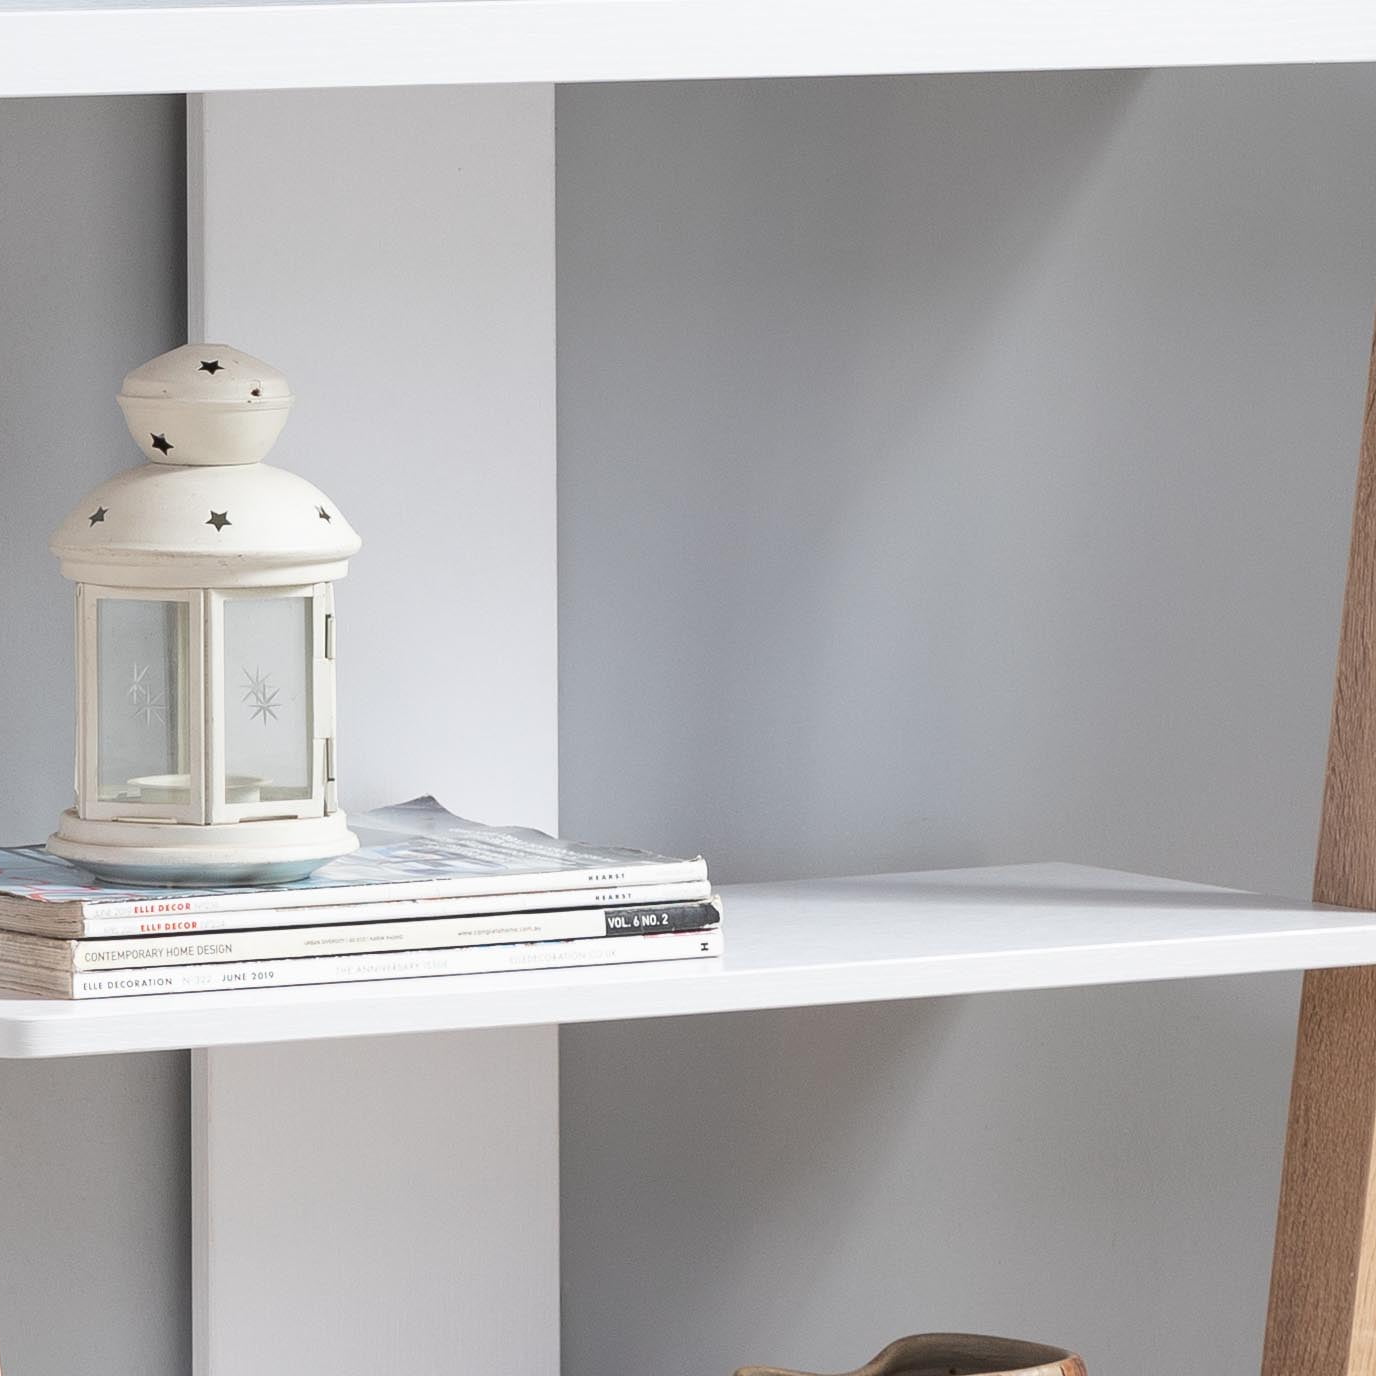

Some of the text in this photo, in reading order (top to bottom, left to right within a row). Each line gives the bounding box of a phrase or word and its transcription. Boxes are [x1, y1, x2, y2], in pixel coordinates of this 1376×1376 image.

[588, 873, 625, 881] HEARST
[595, 892, 632, 901] HEARST
[134, 906, 155, 914] ELLE
[158, 903, 191, 912] DECOR
[140, 924, 162, 932] ELLE
[165, 921, 198, 931] DECOR
[608, 913, 669, 929] VOL. 6 NO. 2
[85, 943, 232, 962] CONTEMPORARY HOME DESIGN
[83, 982, 102, 991] ELLE
[107, 977, 173, 989] DECORATION
[222, 972, 246, 982] JUNE
[252, 971, 274, 980] 2019
